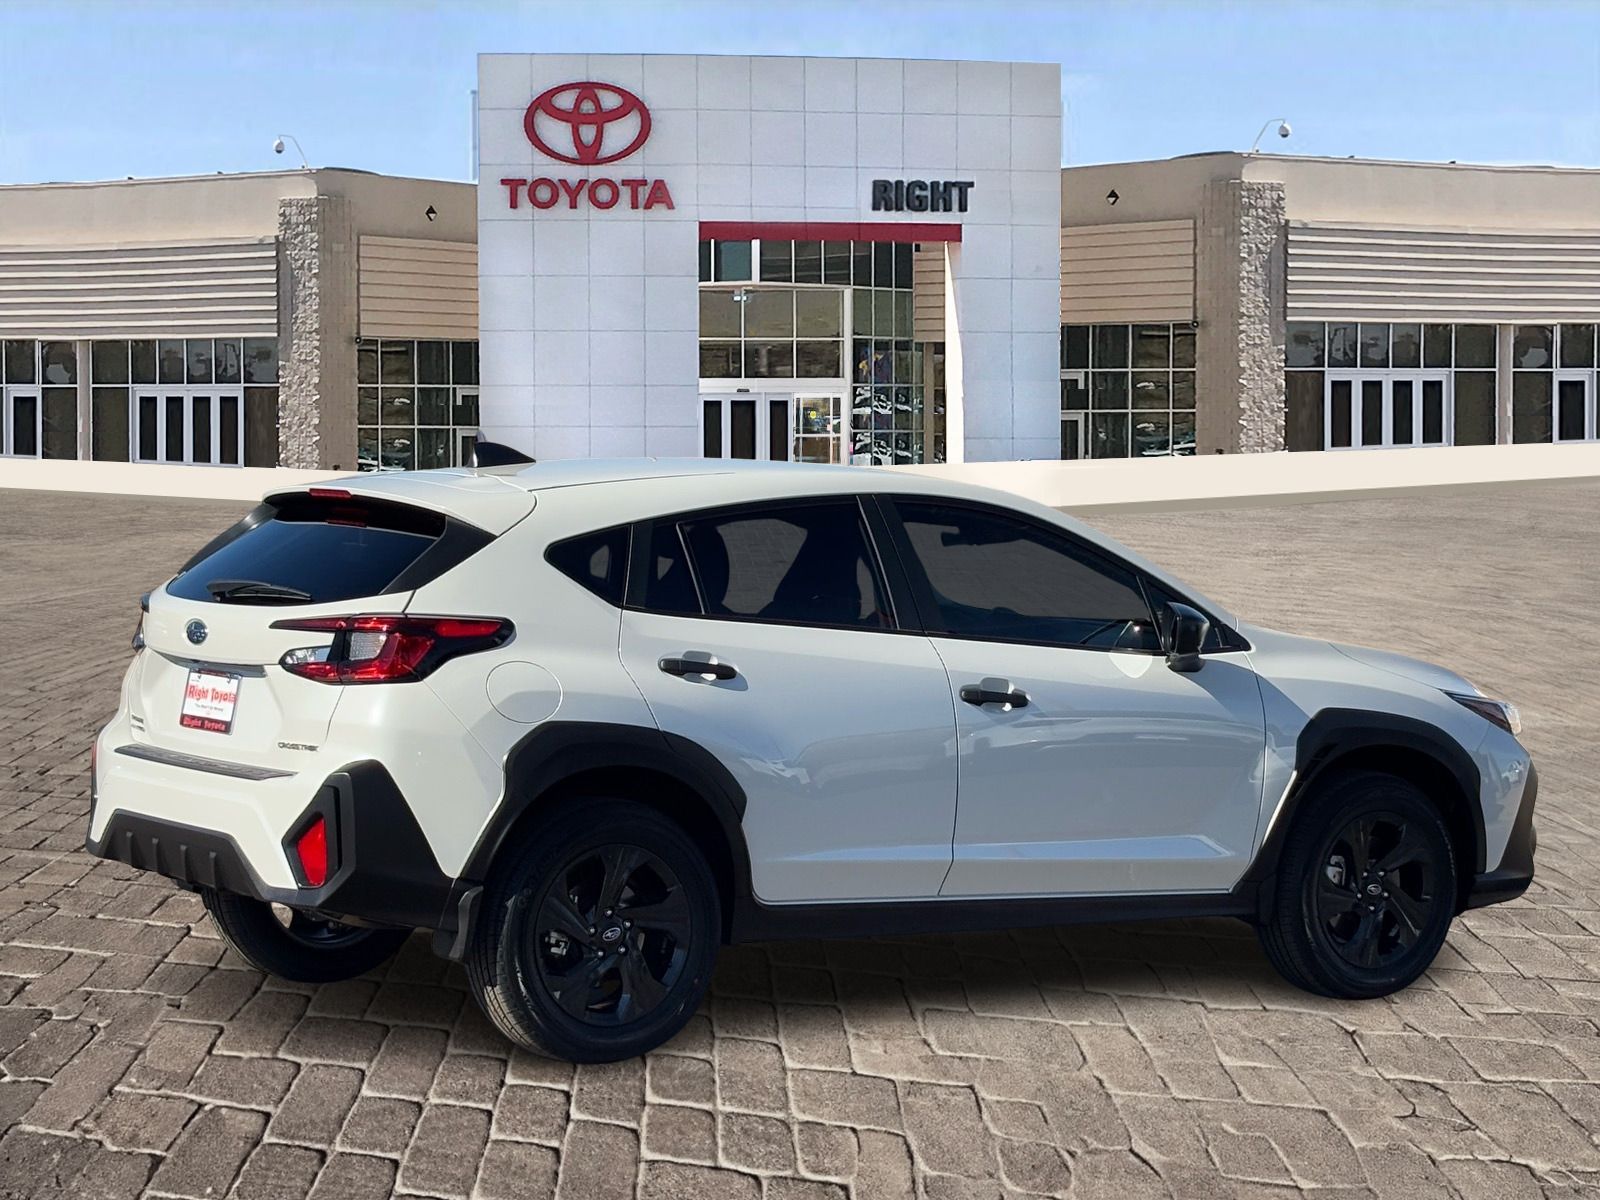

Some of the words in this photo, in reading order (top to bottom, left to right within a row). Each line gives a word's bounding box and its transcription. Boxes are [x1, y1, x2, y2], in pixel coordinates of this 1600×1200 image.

[500, 177, 675, 210] TOYOTA
[872, 179, 975, 213] RIGHT
[188, 684, 209, 701] Right
[210, 687, 237, 704] Toyota
